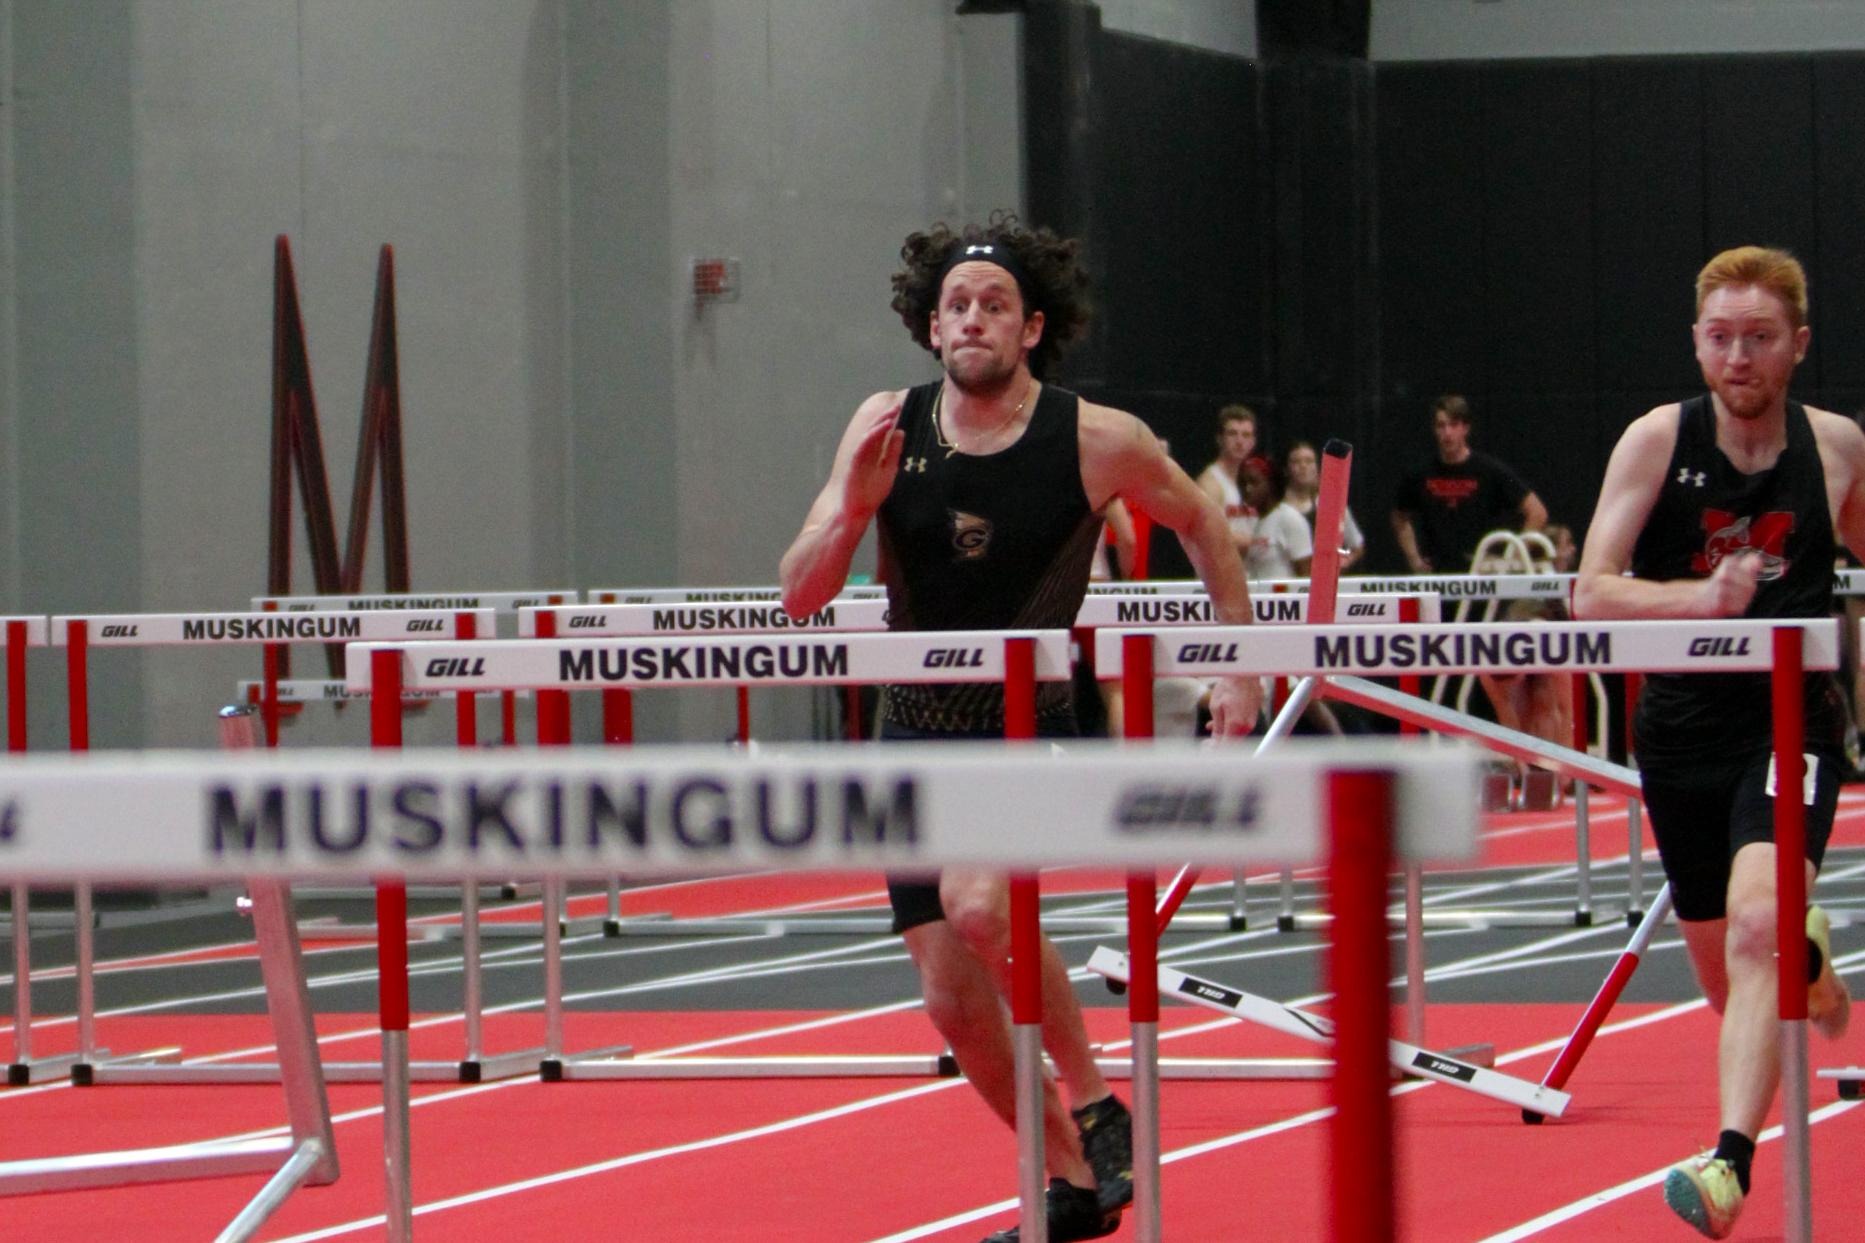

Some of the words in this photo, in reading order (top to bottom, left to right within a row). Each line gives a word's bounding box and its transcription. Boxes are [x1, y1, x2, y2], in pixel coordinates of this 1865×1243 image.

[1360, 581, 1496, 595] MUSKINGUM
[1531, 582, 1560, 591] GILL
[569, 615, 606, 628] GILL
[1118, 600, 1300, 622] MUSKIUM
[1347, 603, 1386, 616] GILL
[101, 625, 138, 637] GILL
[183, 617, 361, 640] MUSKINGUM
[406, 619, 443, 631] GILL
[1177, 643, 1239, 663] GILL
[1314, 631, 1611, 668] MUSKINGUM
[1688, 636, 1752, 656] GILL
[425, 657, 485, 677] GILL
[559, 644, 848, 681] MUSKINGUM
[923, 649, 984, 667] GILL
[207, 776, 921, 856] MUSKINGUM
